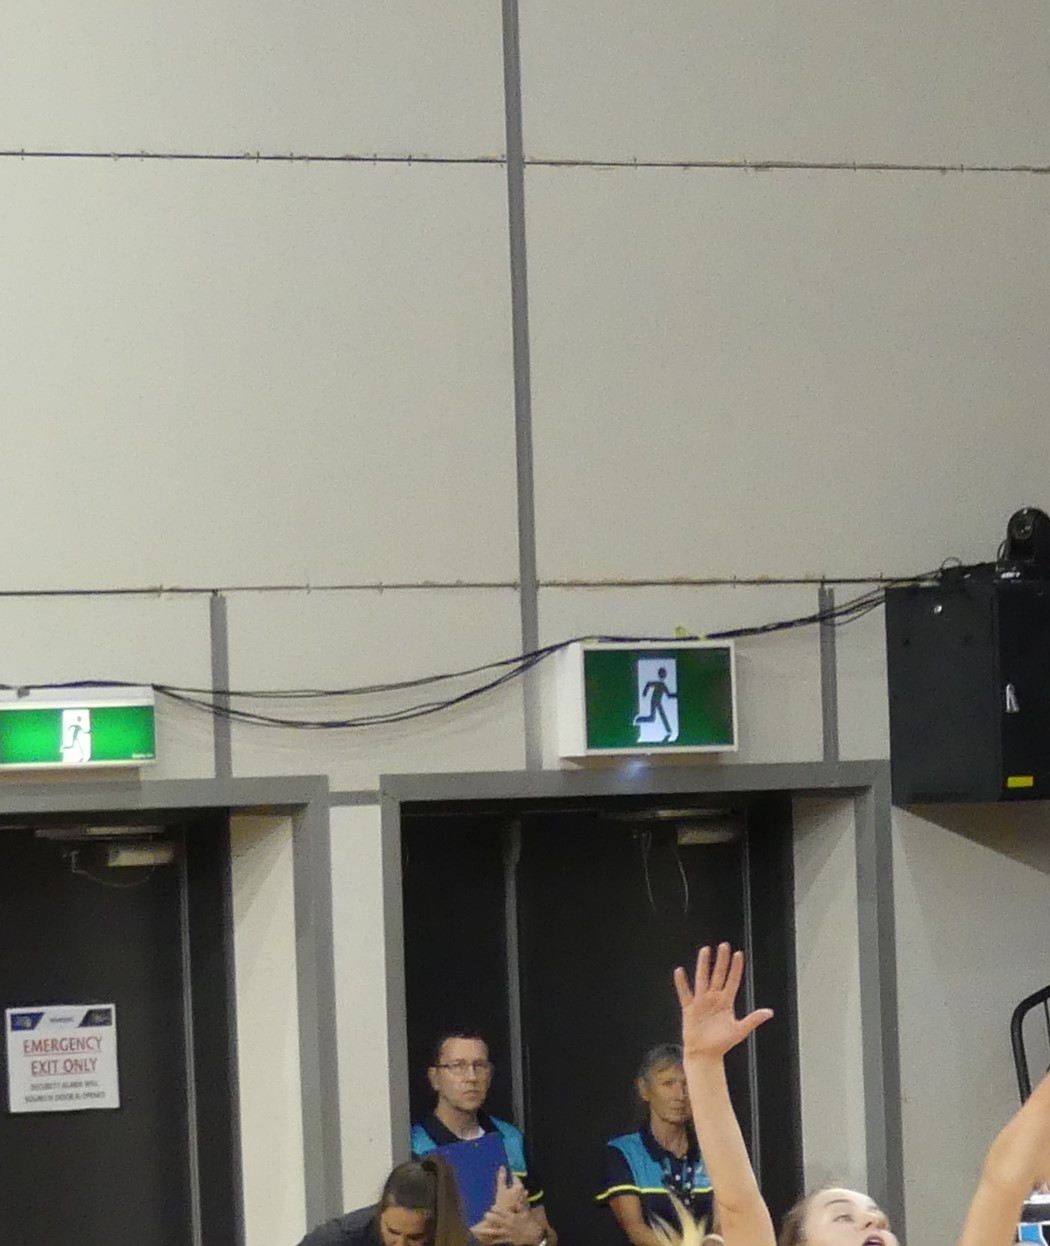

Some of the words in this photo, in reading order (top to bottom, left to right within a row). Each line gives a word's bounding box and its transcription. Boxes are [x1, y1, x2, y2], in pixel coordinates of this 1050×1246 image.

[23, 1036, 102, 1054] EMERGENCY
[31, 1060, 59, 1076] EXIT
[63, 1058, 98, 1073] ONLY
